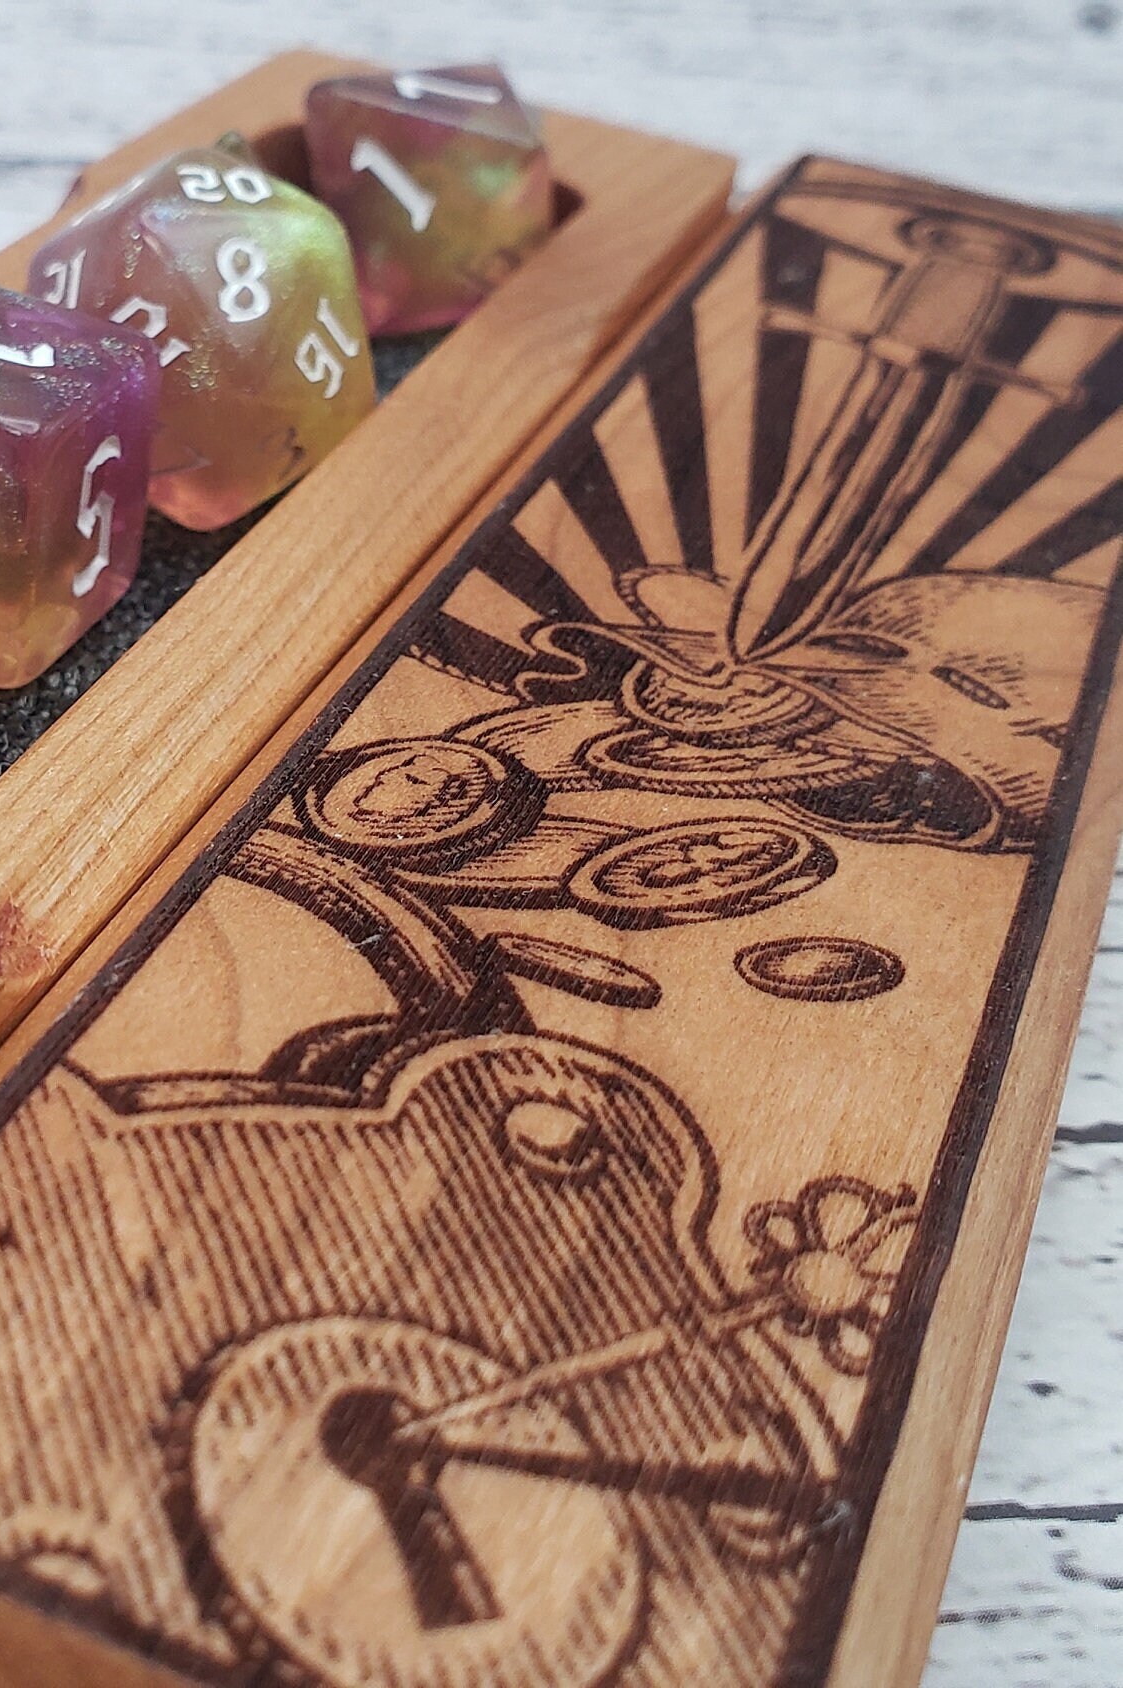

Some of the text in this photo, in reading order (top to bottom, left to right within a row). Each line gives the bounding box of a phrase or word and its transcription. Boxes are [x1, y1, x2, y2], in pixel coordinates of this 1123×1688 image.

[176, 164, 273, 205] 20
[350, 136, 437, 233] 1
[216, 236, 271, 323] 8
